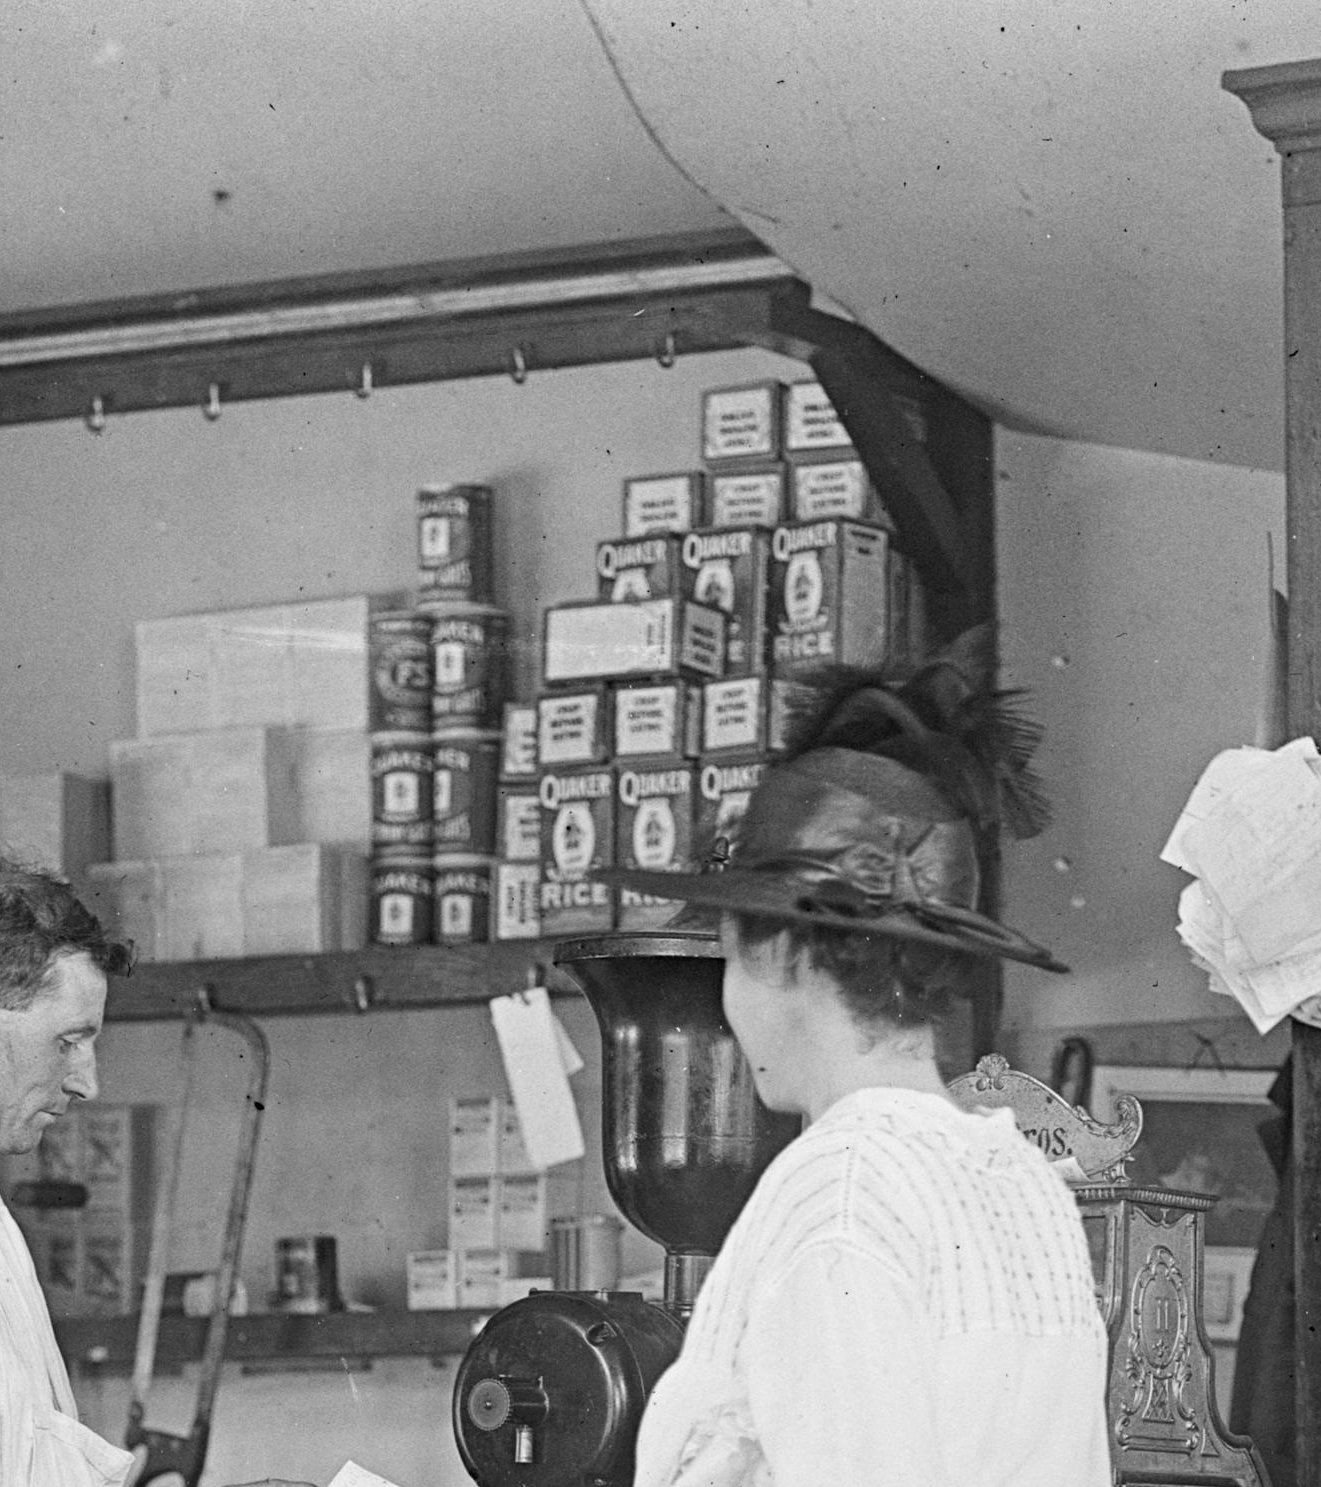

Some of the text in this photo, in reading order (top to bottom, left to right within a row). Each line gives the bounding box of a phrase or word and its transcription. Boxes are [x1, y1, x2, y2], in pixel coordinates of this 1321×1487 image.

[597, 538, 668, 579] QUAKER
[682, 531, 753, 569] QUAKER
[773, 521, 838, 562] QUAKER
[774, 630, 834, 661] RICE
[539, 772, 612, 810] QUAKER
[619, 769, 692, 806] QUAKER
[700, 764, 766, 800] QUAKE
[540, 882, 609, 909] RICE
